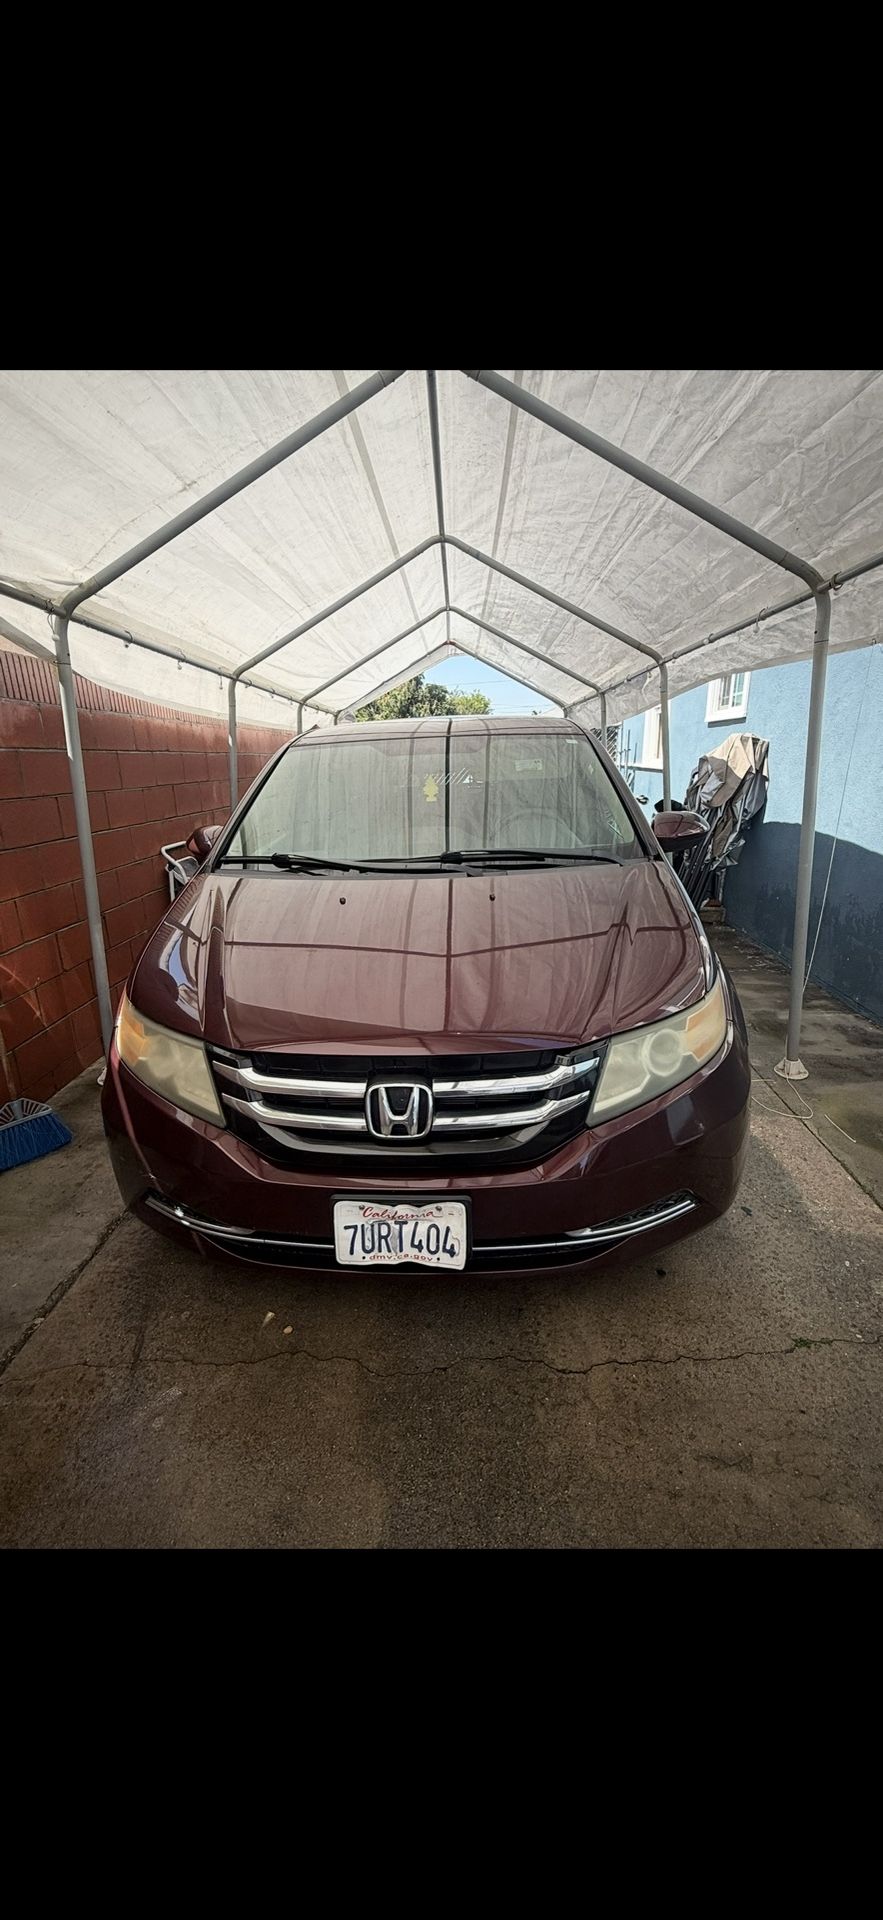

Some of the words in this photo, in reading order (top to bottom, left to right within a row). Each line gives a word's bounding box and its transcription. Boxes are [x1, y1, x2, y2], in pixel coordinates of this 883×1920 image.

[362, 1206, 443, 1220] California
[343, 1220, 456, 1258] 7URT404
[369, 1253, 433, 1262] dmv.ca.gov
